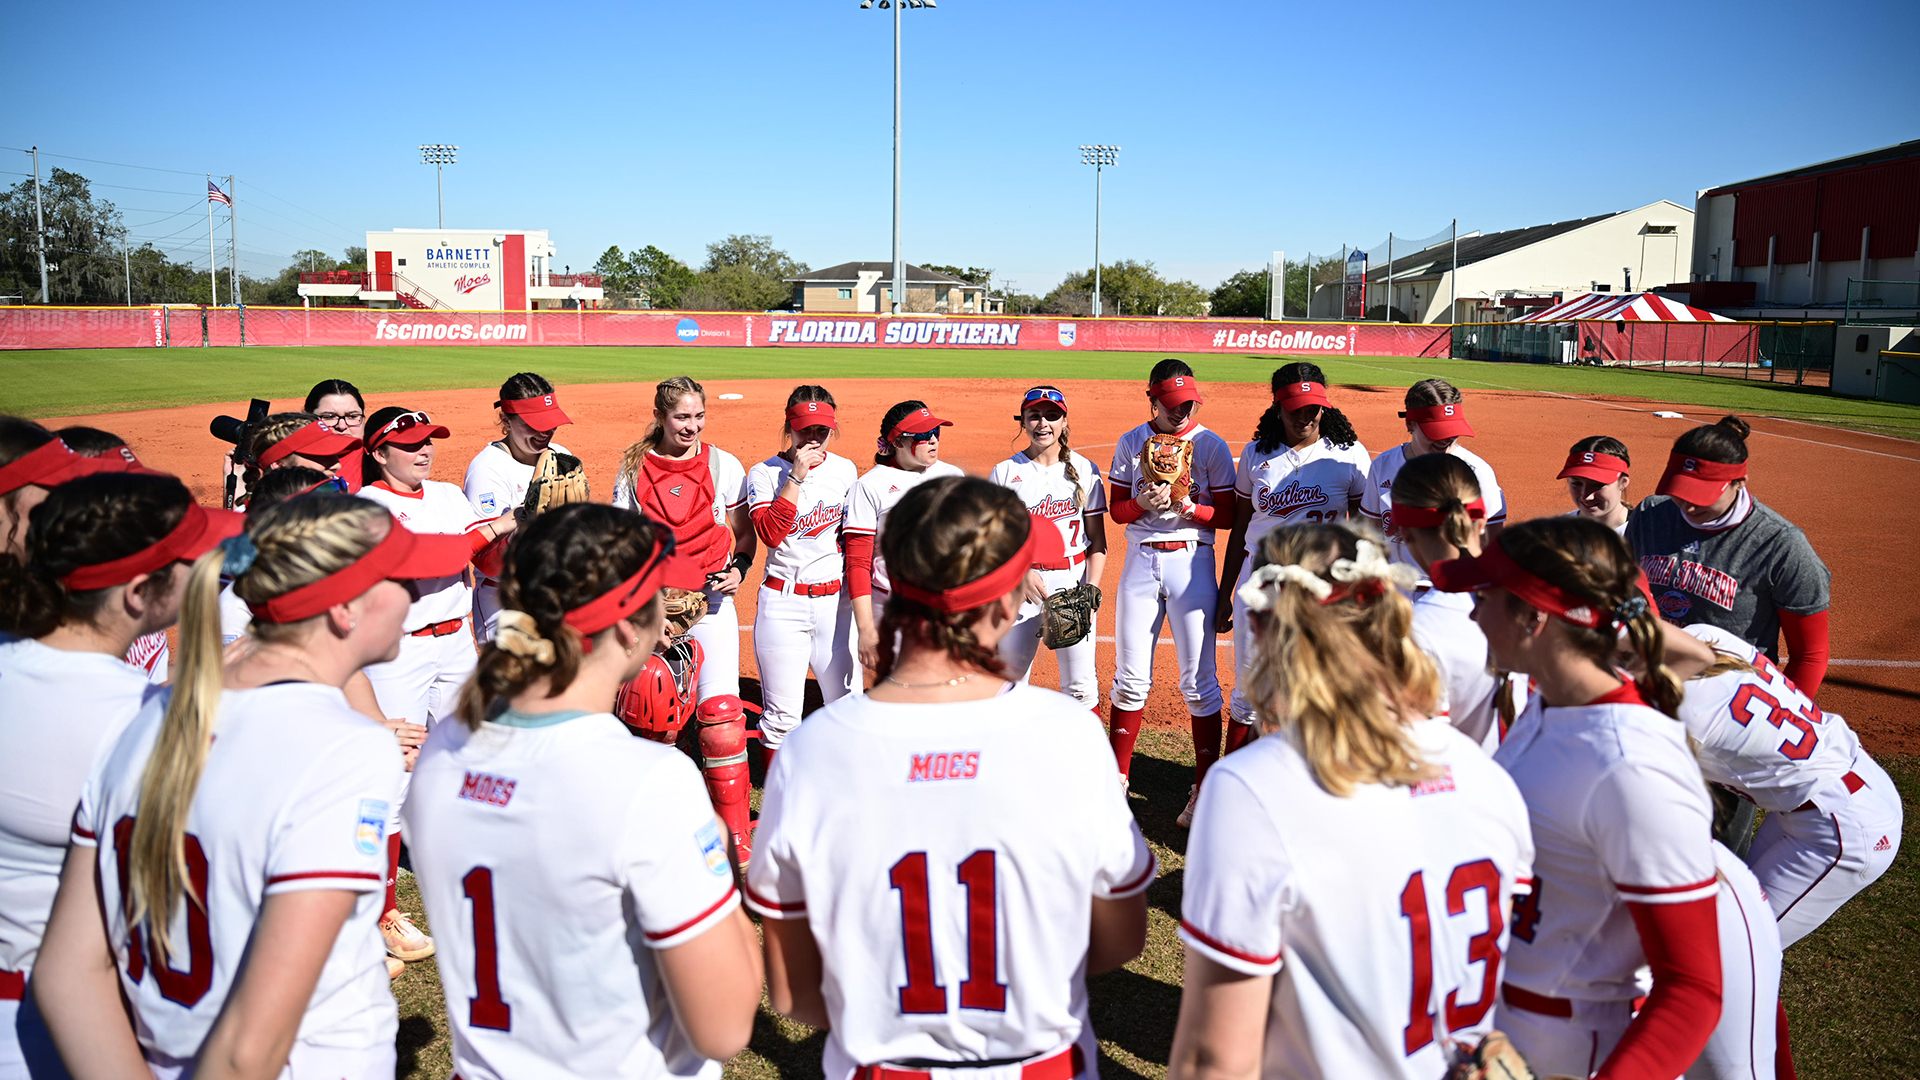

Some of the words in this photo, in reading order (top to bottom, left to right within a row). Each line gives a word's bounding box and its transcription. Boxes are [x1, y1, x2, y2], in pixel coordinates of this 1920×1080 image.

[426, 248, 490, 260] BARNETT
[454, 273, 491, 293] Mocs
[155, 326, 163, 347] 230
[376, 319, 527, 340] fscmocs.com
[768, 320, 877, 344] FLORIDA
[884, 321, 1021, 345] SOUTHERN
[1212, 329, 1347, 350] #LetsGoMocs
[1175, 377, 1184, 387] S
[1301, 382, 1311, 392] S
[543, 395, 553, 406] S
[808, 402, 818, 412] S
[1444, 404, 1454, 416] S
[920, 408, 930, 417] S
[1583, 452, 1595, 463] S
[1683, 458, 1696, 471] S
[1258, 480, 1329, 513] Southern
[1069, 520, 1080, 547] 7
[1673, 560, 1738, 611] SOUTHERN
[908, 752, 980, 782] MOCS
[458, 771, 517, 807] MOCS
[889, 848, 1008, 1015] 11
[462, 865, 511, 1032] 1
[1400, 858, 1503, 1057] 13
